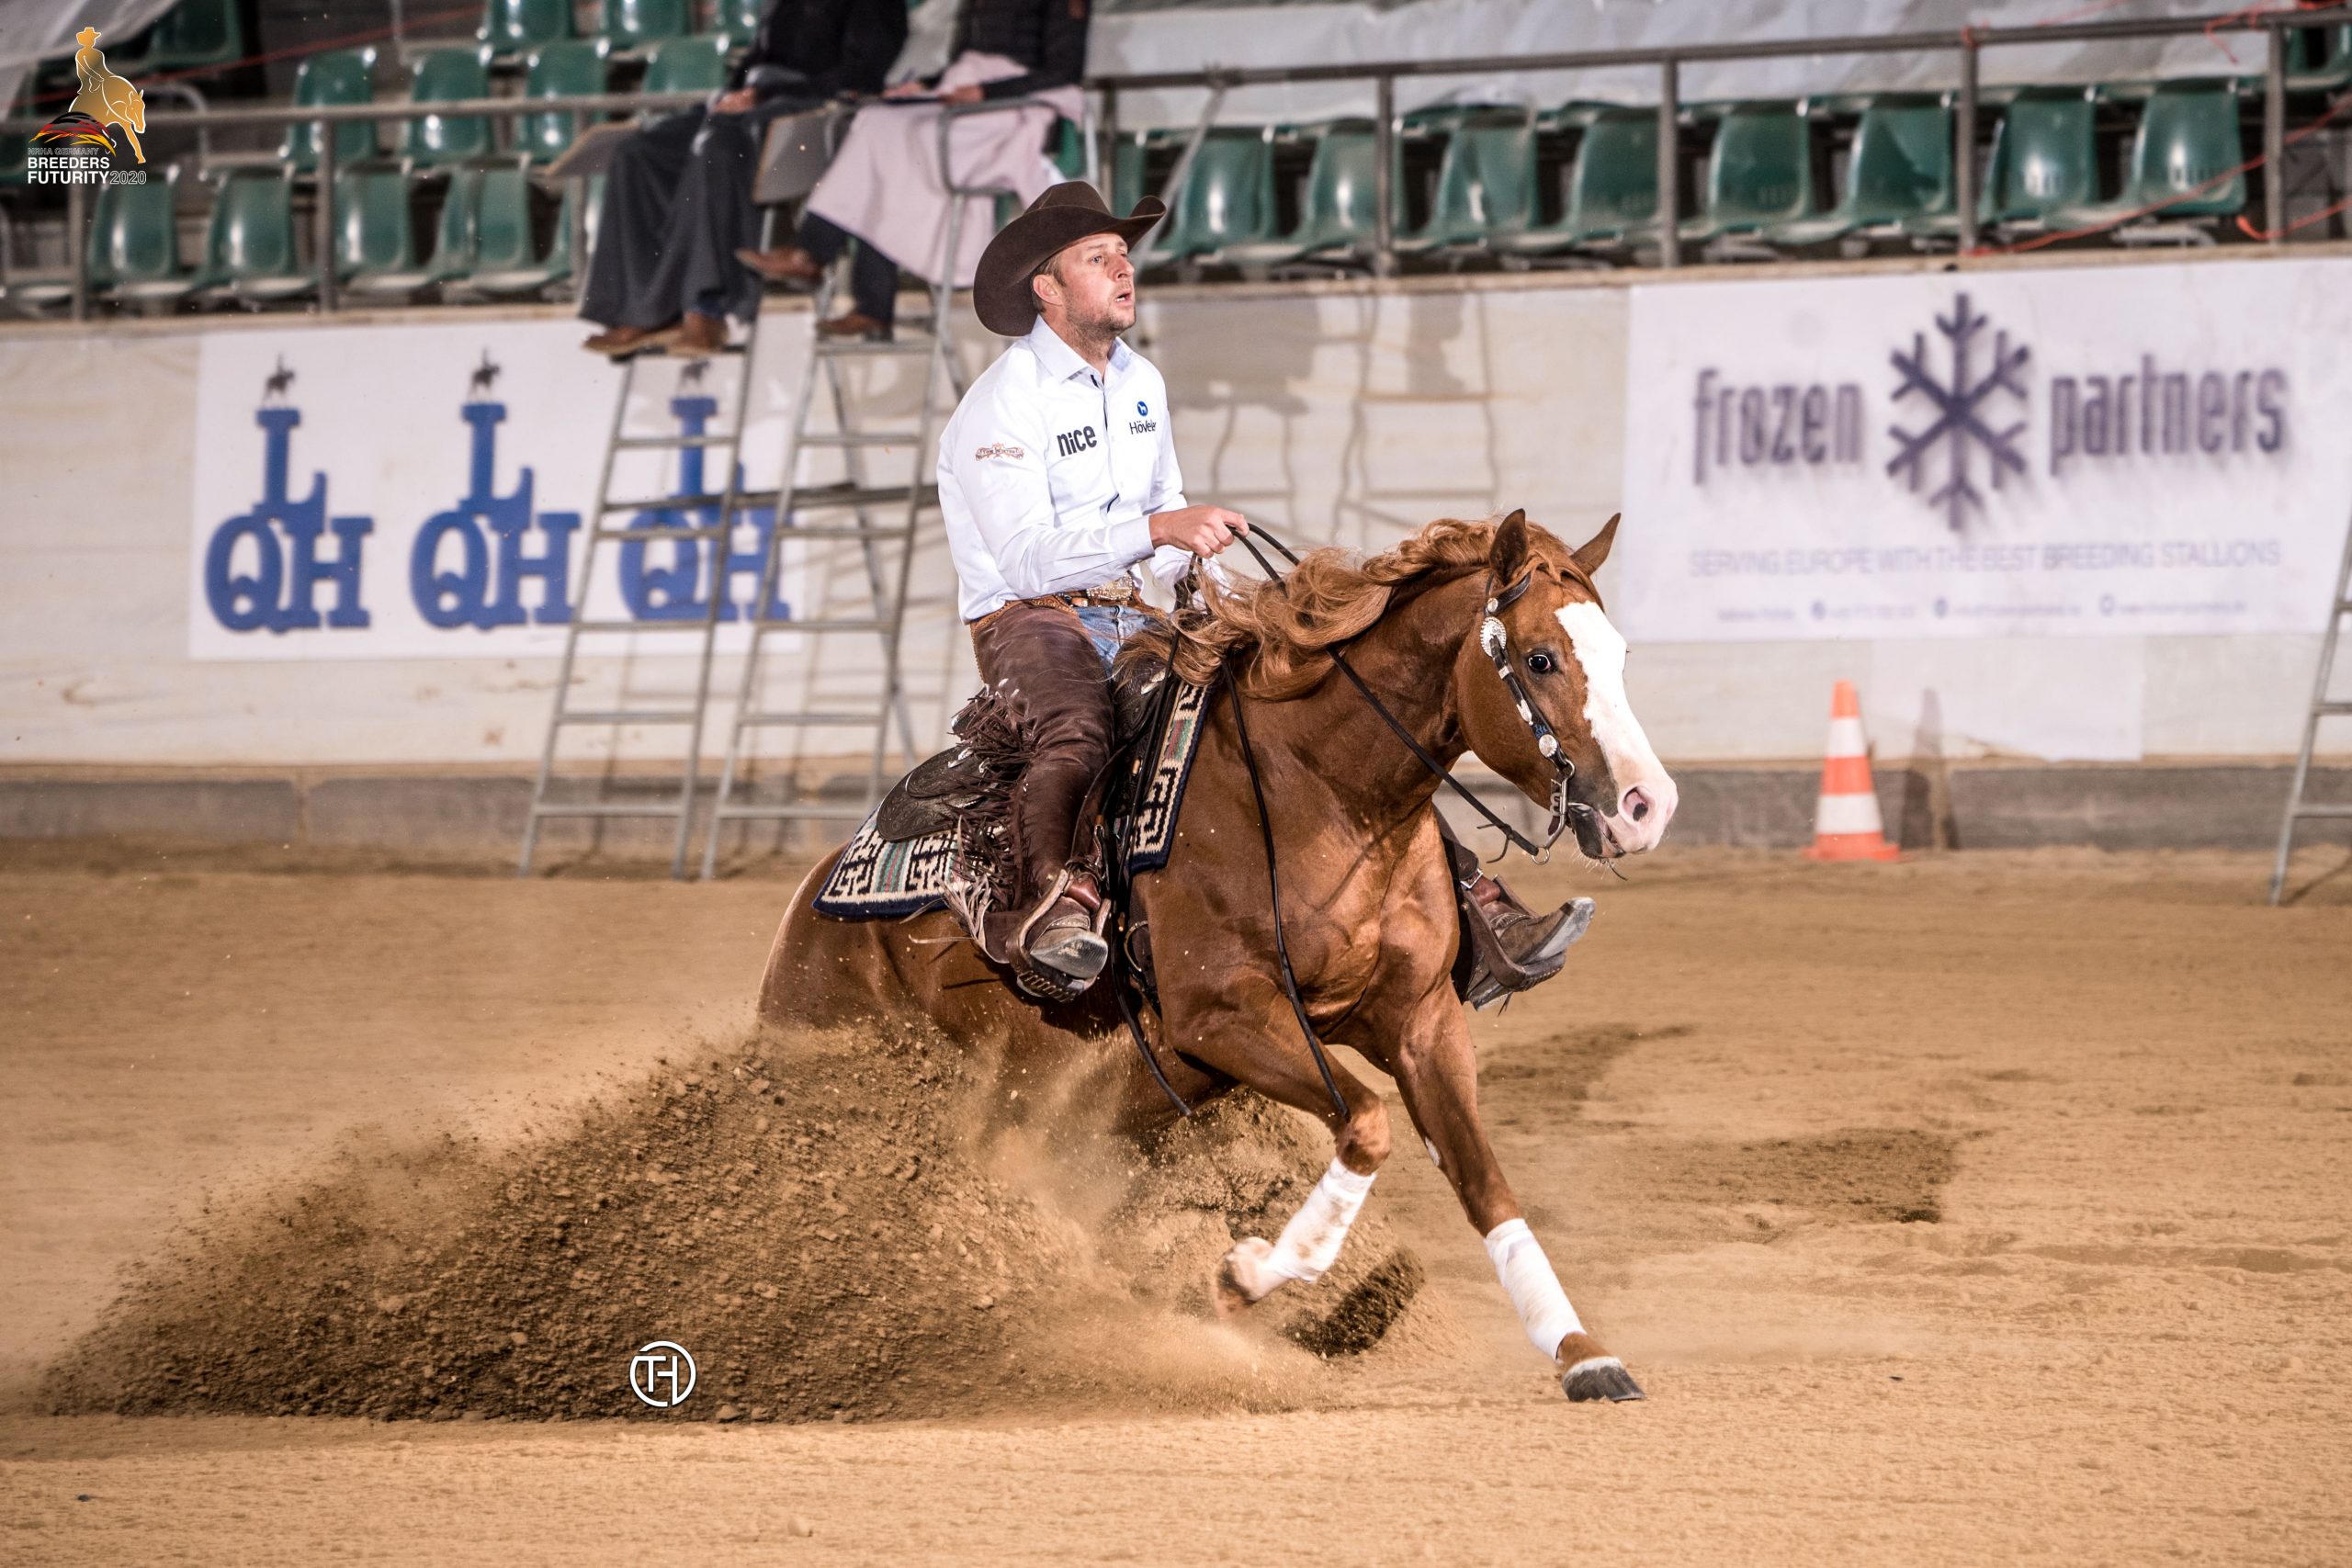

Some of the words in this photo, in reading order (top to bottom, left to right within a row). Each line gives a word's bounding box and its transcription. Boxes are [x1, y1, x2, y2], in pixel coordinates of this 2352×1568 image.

[1693, 368, 1862, 486] frozen
[2050, 353, 2288, 477] partners
[1057, 425, 1097, 457] nice
[1689, 548, 1780, 577] SERVING
[1785, 547, 1873, 575] EUROPE
[1878, 547, 1929, 572] WITH
[1936, 546, 1978, 572] THE
[1983, 544, 2037, 571] BEST
[2042, 542, 2155, 570] BREEDING
[2162, 539, 2281, 568] STALLIONS
